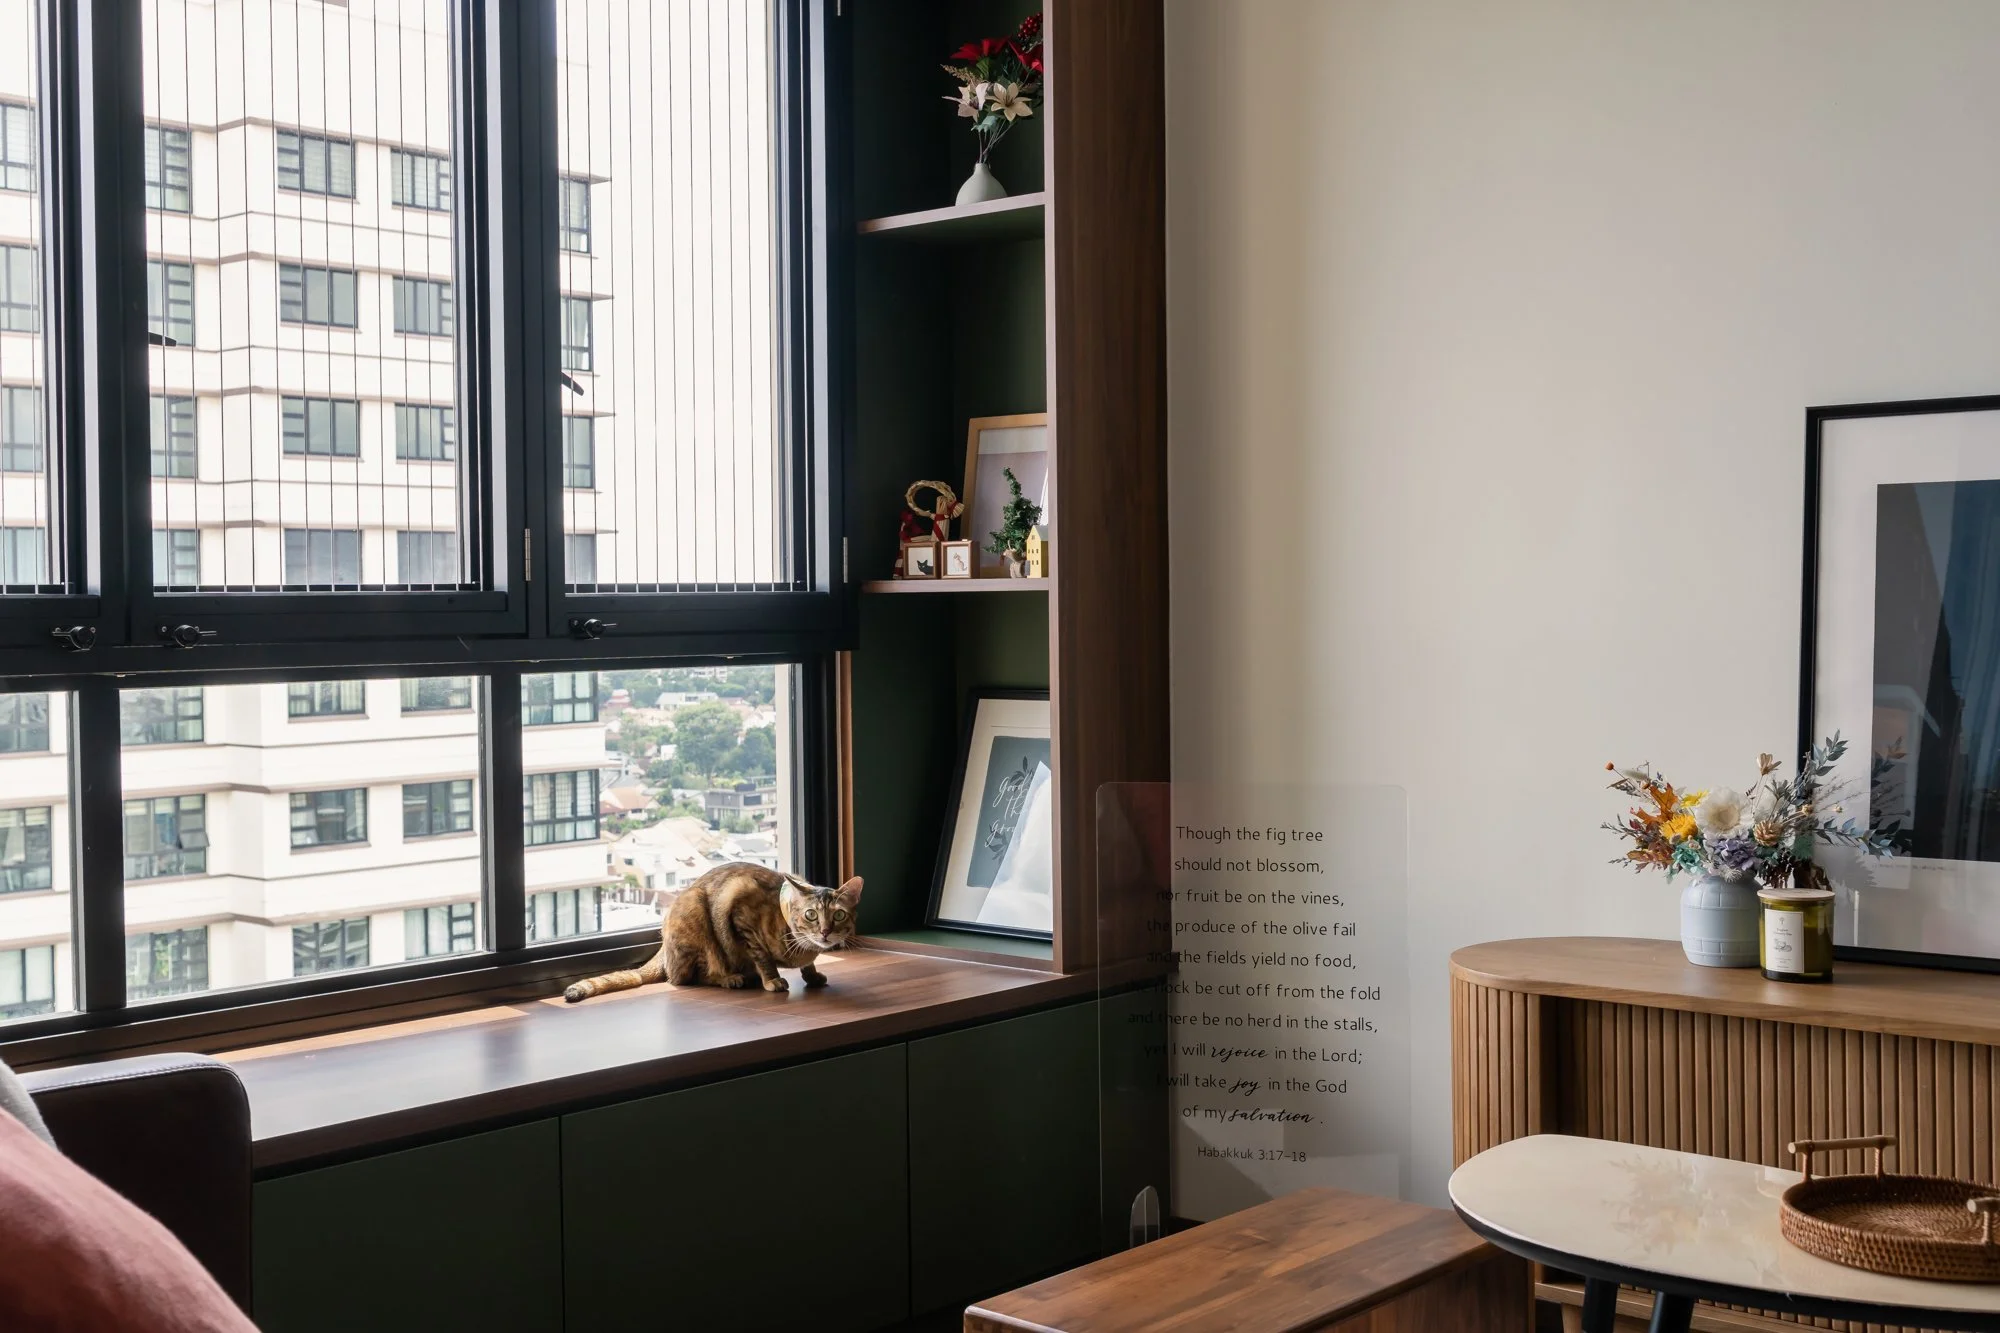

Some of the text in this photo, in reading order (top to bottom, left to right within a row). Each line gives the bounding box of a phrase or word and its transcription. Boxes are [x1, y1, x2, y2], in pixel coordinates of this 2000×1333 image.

[1176, 826, 1323, 845] Though the fig tree
[1175, 857, 1323, 874] should not blossom,
[1156, 889, 1344, 906] nor fruit be on the vines,
[1176, 919, 1235, 936] produce
[1241, 921, 1259, 933] of
[1264, 921, 1287, 934] the
[1293, 921, 1327, 935] olive
[1333, 923, 1355, 936] fail
[1178, 950, 1201, 964] the
[1206, 950, 1247, 964] fields
[1251, 953, 1286, 969] yield
[1289, 955, 1309, 966] no
[1315, 954, 1356, 969] food,
[1195, 981, 1213, 995] be
[1218, 984, 1241, 996] cut
[1246, 983, 1272, 996] off
[1277, 984, 1314, 998] from
[1320, 985, 1344, 999] the
[1350, 986, 1380, 1000] fold
[1158, 1011, 1198, 1026] there
[1203, 1012, 1220, 1026] be
[1225, 1016, 1244, 1028] no
[1248, 1013, 1281, 1027] herd
[1287, 1015, 1298, 1028] in
[1304, 1016, 1328, 1029] the
[1334, 1017, 1377, 1033] stalls,
[1172, 1043, 1177, 1056] I
[1182, 1042, 1207, 1057] will
[1211, 1045, 1268, 1063] rejoice
[1275, 1047, 1286, 1059] in
[1292, 1047, 1316, 1061] the
[1321, 1048, 1362, 1064] Lord;
[1166, 1074, 1189, 1087] will
[1194, 1074, 1227, 1089] take
[1228, 1079, 1261, 1096] joy
[1269, 1077, 1280, 1090] in
[1285, 1077, 1310, 1092] the
[1314, 1080, 1346, 1093] God
[1182, 1105, 1200, 1118] of
[1204, 1107, 1227, 1123] my
[1197, 1145, 1253, 1159] Habakkuk
